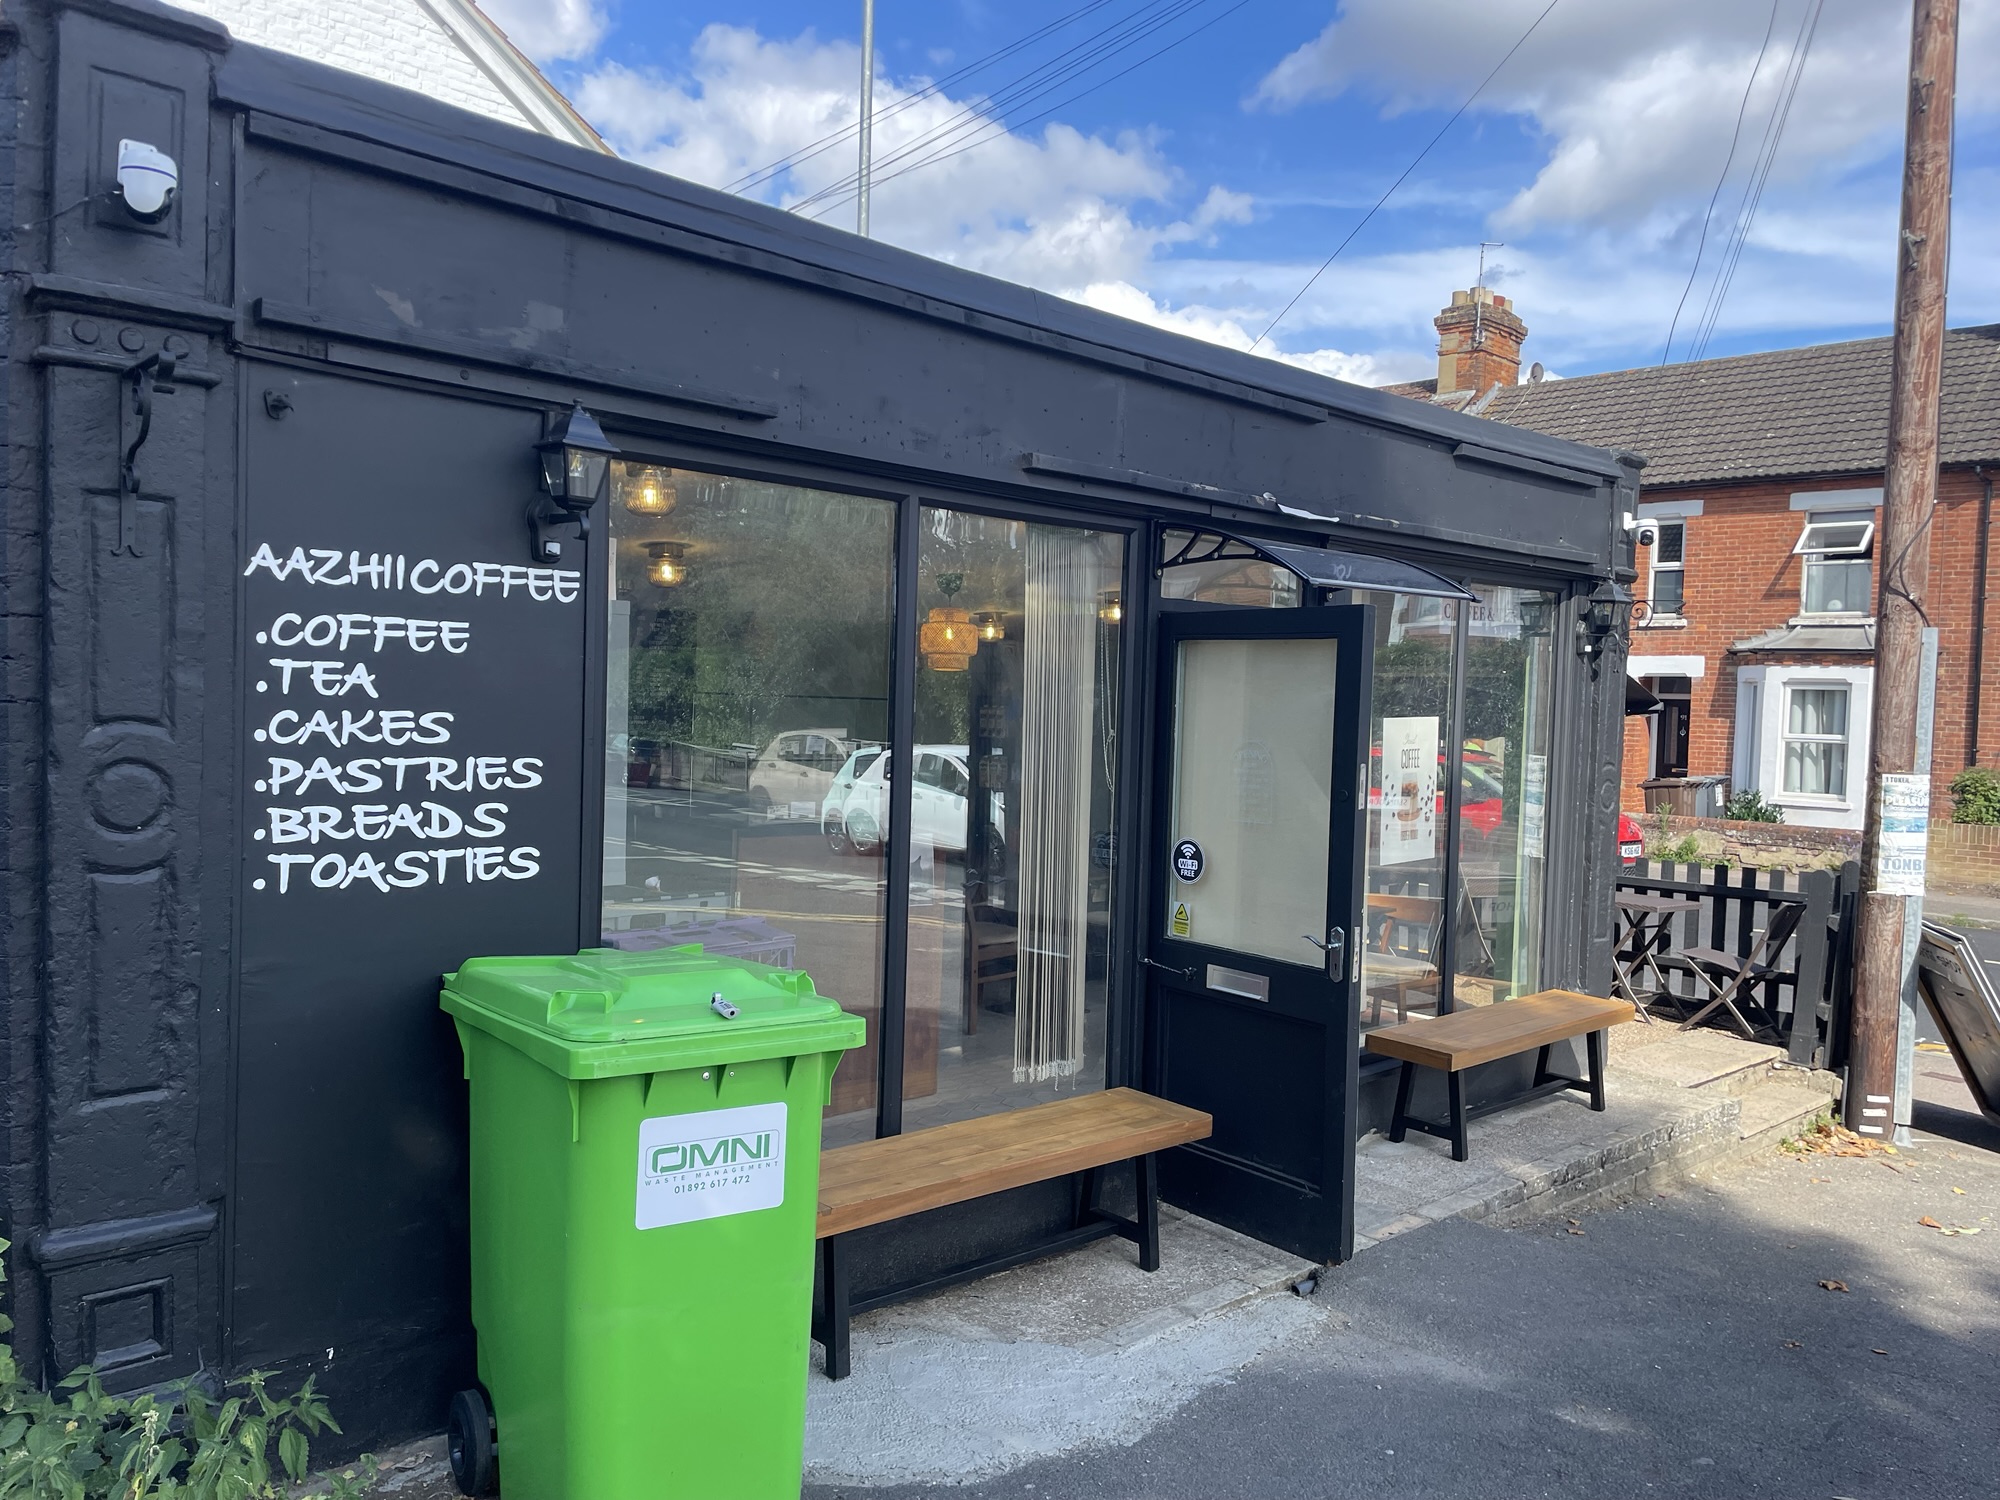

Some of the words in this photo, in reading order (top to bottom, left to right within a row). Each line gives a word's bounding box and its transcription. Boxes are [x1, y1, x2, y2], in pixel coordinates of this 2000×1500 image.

[1401, 748, 1420, 769] COFFEE
[1180, 869, 1195, 877] FREE
[651, 1133, 771, 1174] OMNI
[645, 1174, 686, 1187] WASTE
[695, 1160, 779, 1179] MANAGEMENT
[674, 1180, 706, 1194] 01892
[710, 1177, 728, 1189] 617
[732, 1174, 750, 1185] 472
